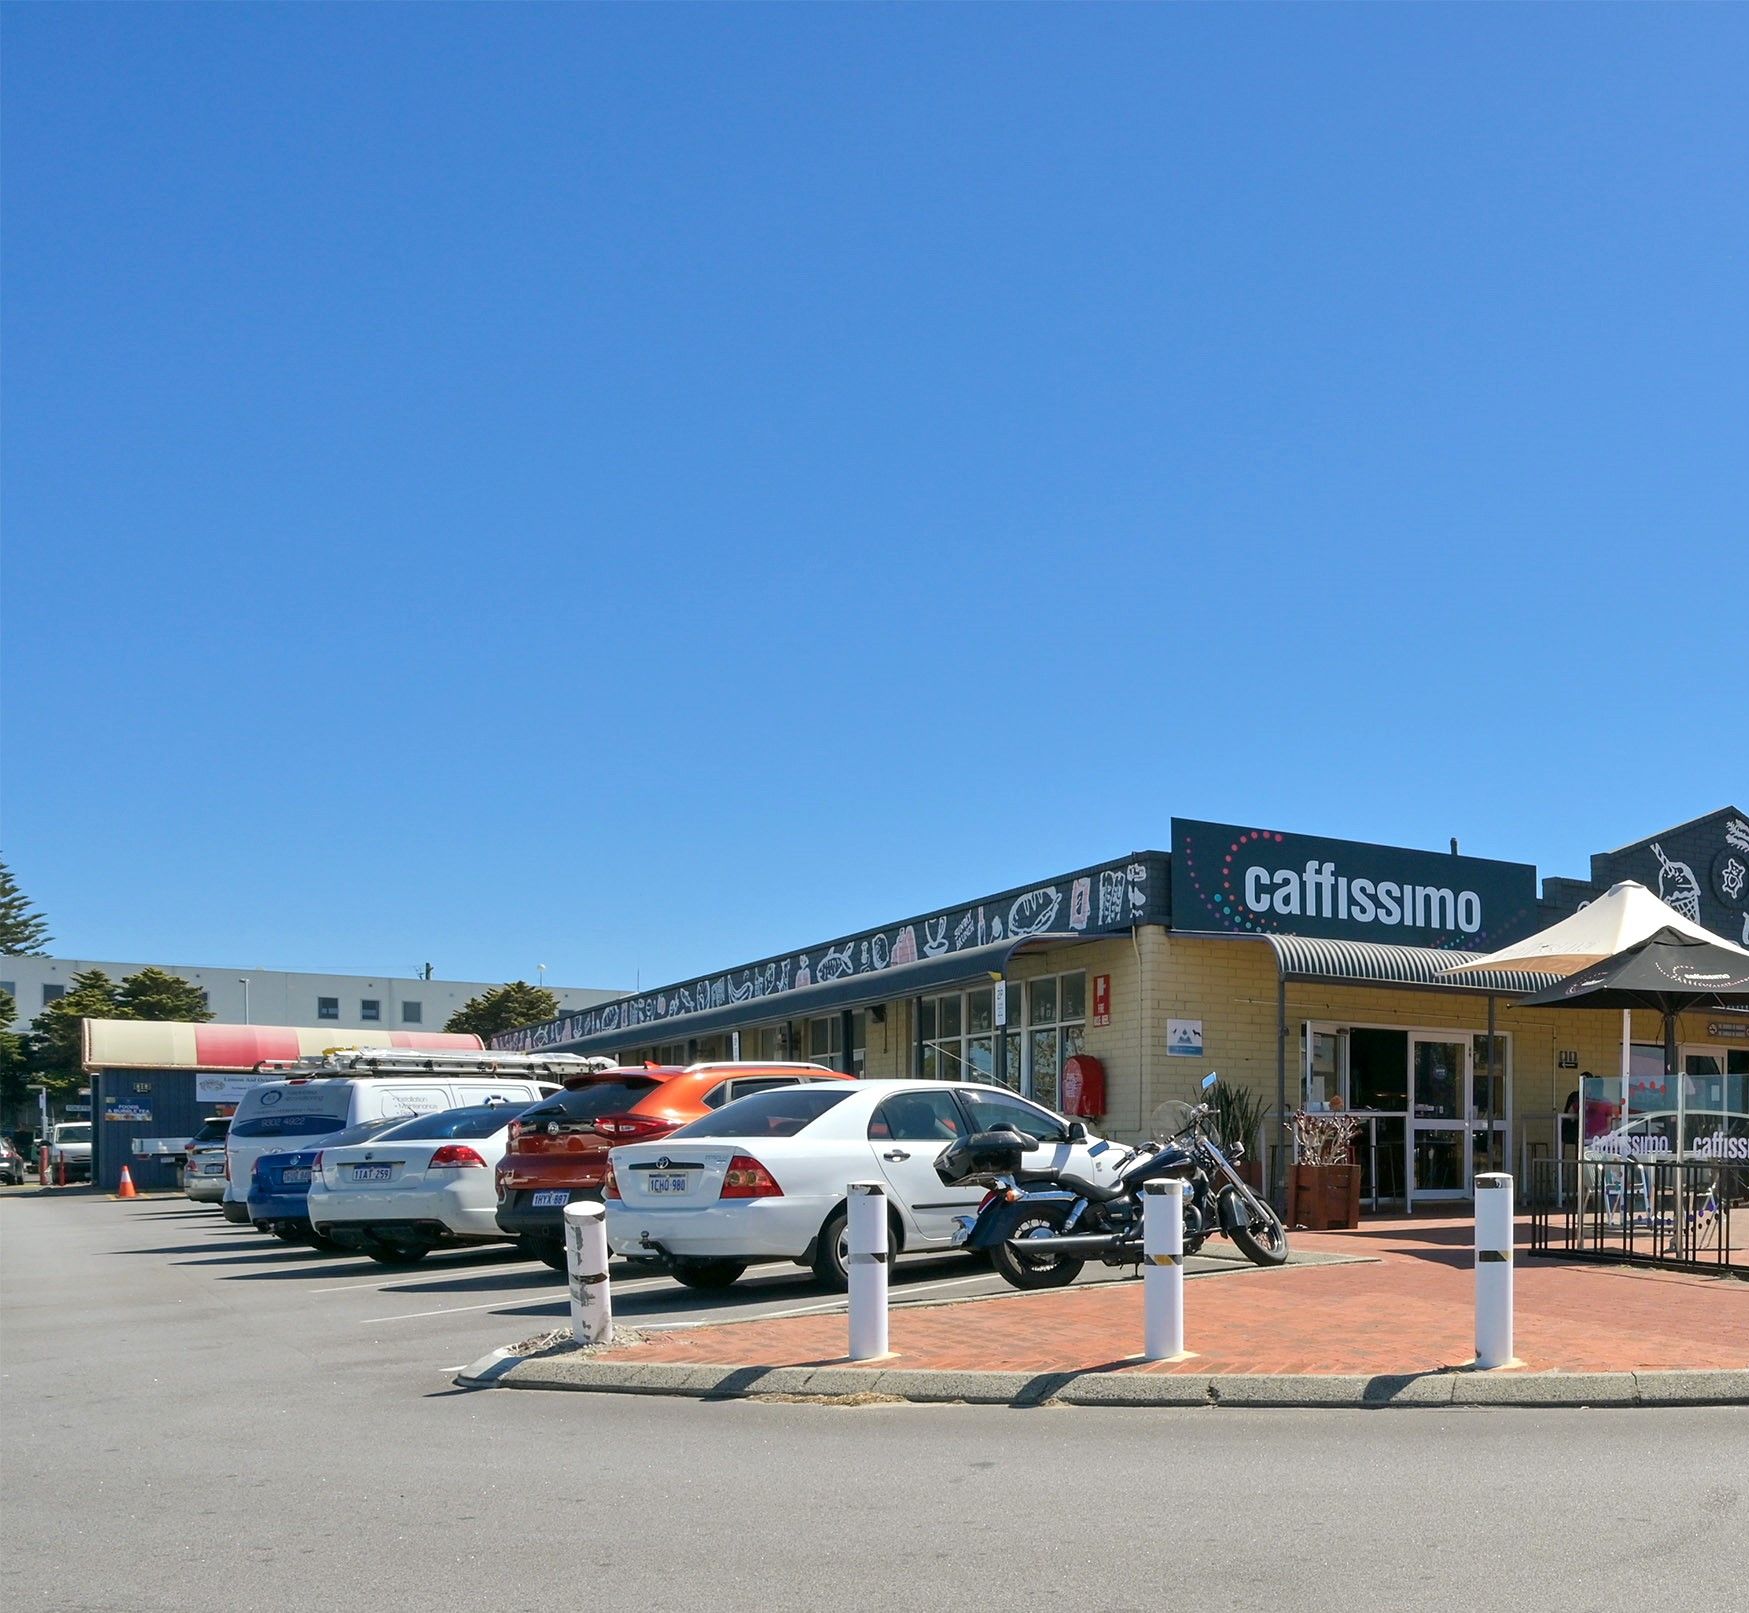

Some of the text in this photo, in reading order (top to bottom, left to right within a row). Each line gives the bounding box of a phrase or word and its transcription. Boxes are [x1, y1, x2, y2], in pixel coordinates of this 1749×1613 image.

[1244, 860, 1481, 933] caffissimo
[1592, 1132, 1669, 1156] caffissimo
[374, 1167, 390, 1180] 259
[672, 1181, 686, 1193] 980
